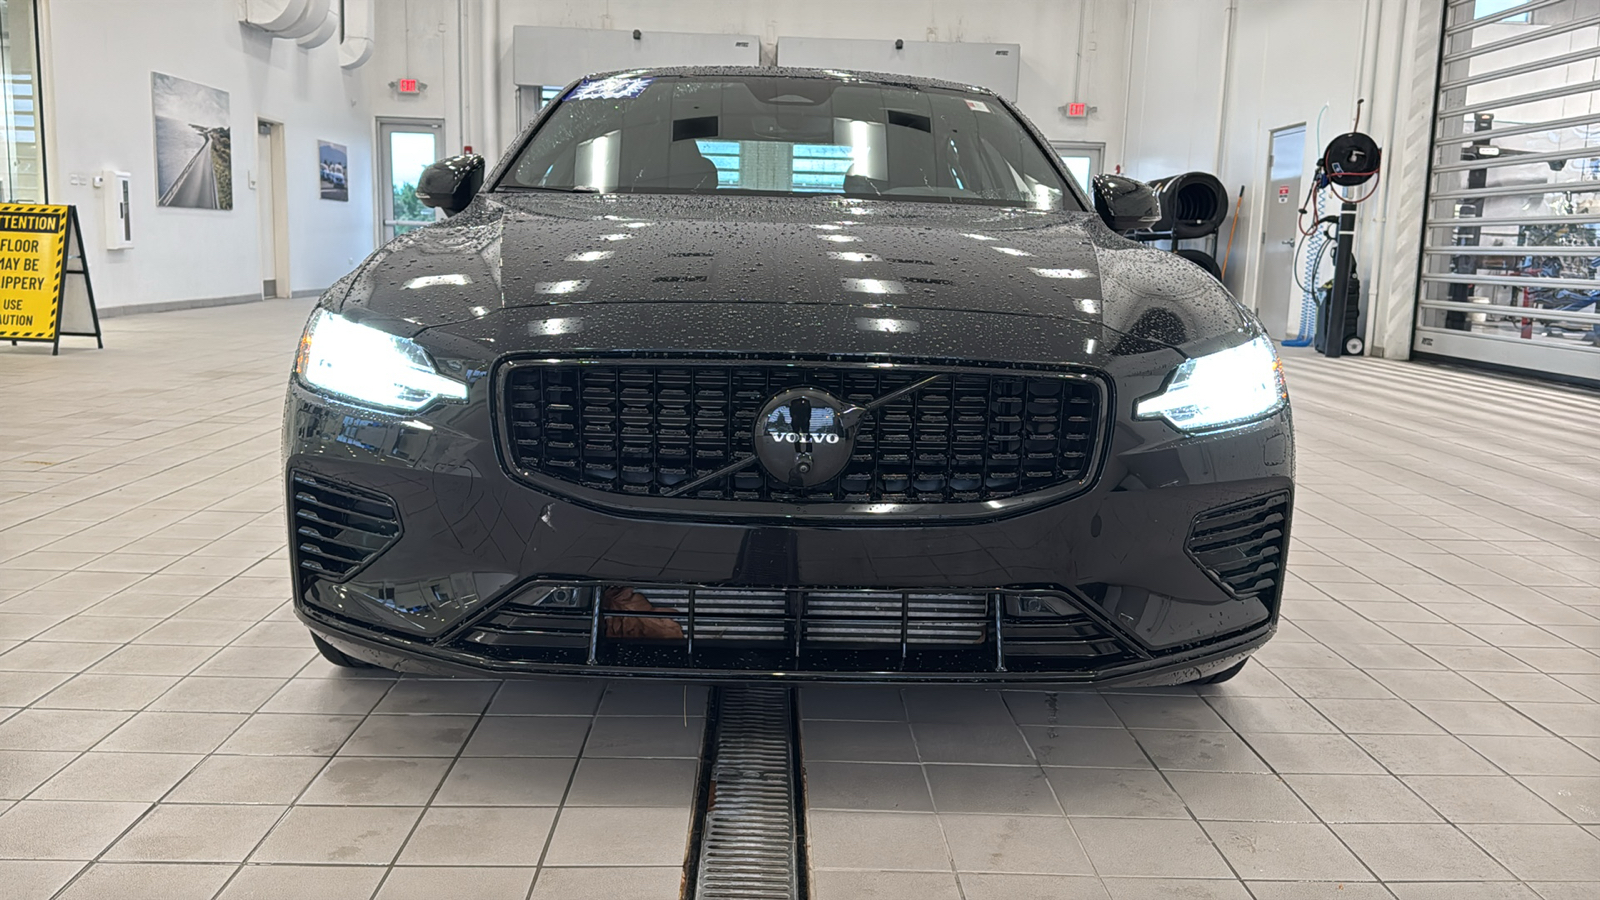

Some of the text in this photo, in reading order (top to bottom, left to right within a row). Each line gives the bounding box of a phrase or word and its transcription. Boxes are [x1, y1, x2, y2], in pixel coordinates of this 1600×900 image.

[0, 239, 39, 253] FLOOR
[23, 258, 39, 271] BE
[1, 276, 45, 290] IPPERY
[3, 299, 23, 310] USE
[0, 314, 33, 326] UTION
[769, 431, 839, 444] VOLVO
